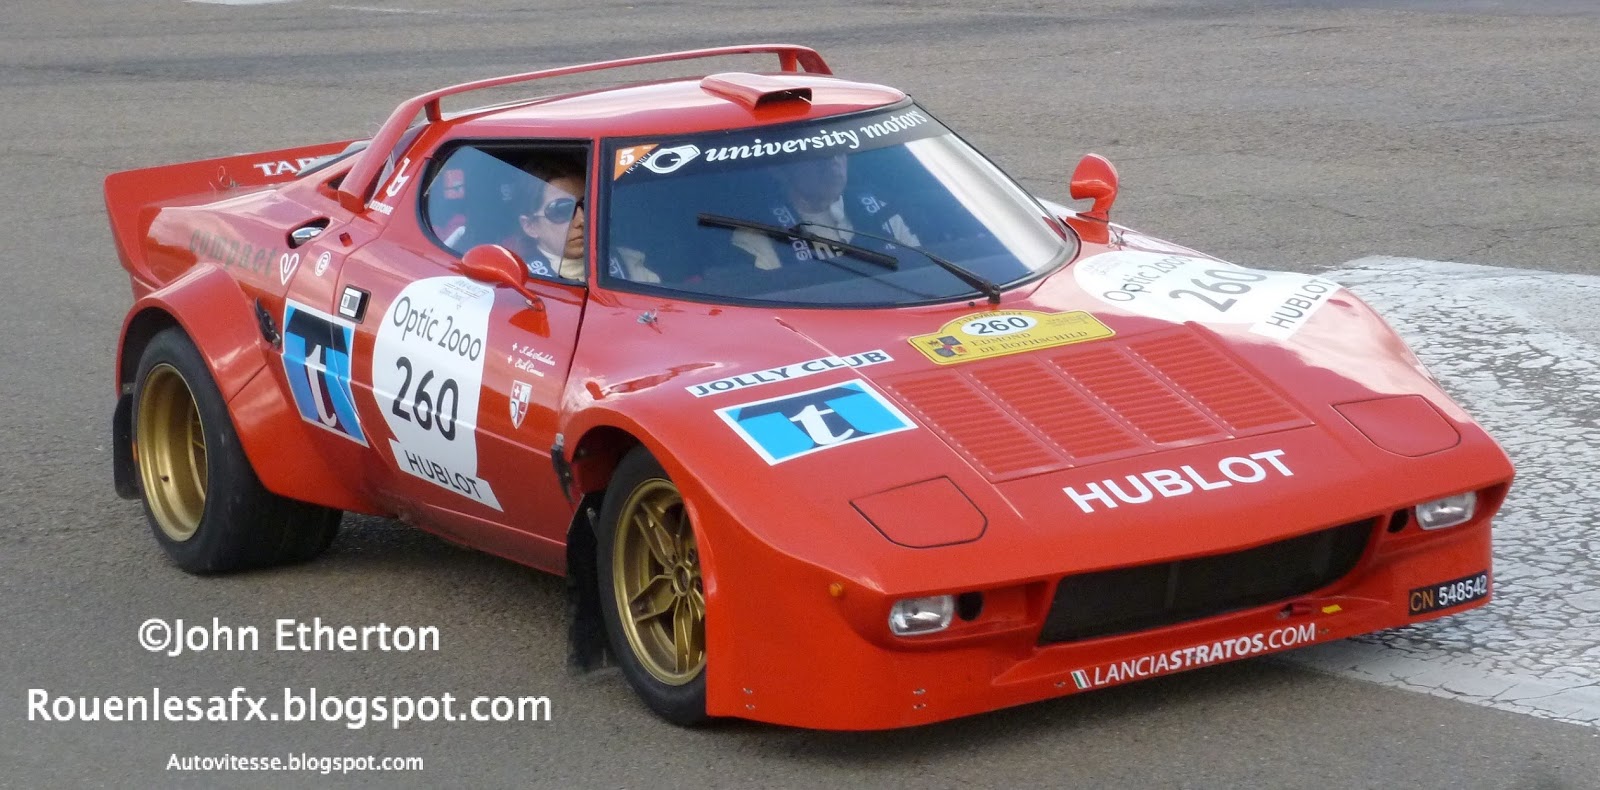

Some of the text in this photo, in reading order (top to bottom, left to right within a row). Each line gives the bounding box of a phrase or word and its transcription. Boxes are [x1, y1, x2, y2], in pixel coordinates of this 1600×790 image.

[619, 148, 635, 166] 5
[705, 109, 927, 162] university motors
[189, 228, 278, 278] compact
[1102, 272, 1161, 301] Optic
[1169, 269, 1267, 313] 260
[1266, 279, 1336, 329] HUBLOT
[393, 296, 439, 341] Optic
[438, 316, 482, 361] 2000
[970, 317, 1029, 335] 260
[696, 351, 888, 396] JOLLY CLUB
[392, 357, 459, 441] 260
[405, 450, 482, 499] HUBLOT
[1062, 449, 1294, 514] HUBLOT
[1410, 575, 1487, 612] CN 548542
[1094, 623, 1316, 686] LANCIASTRATOS.COM
